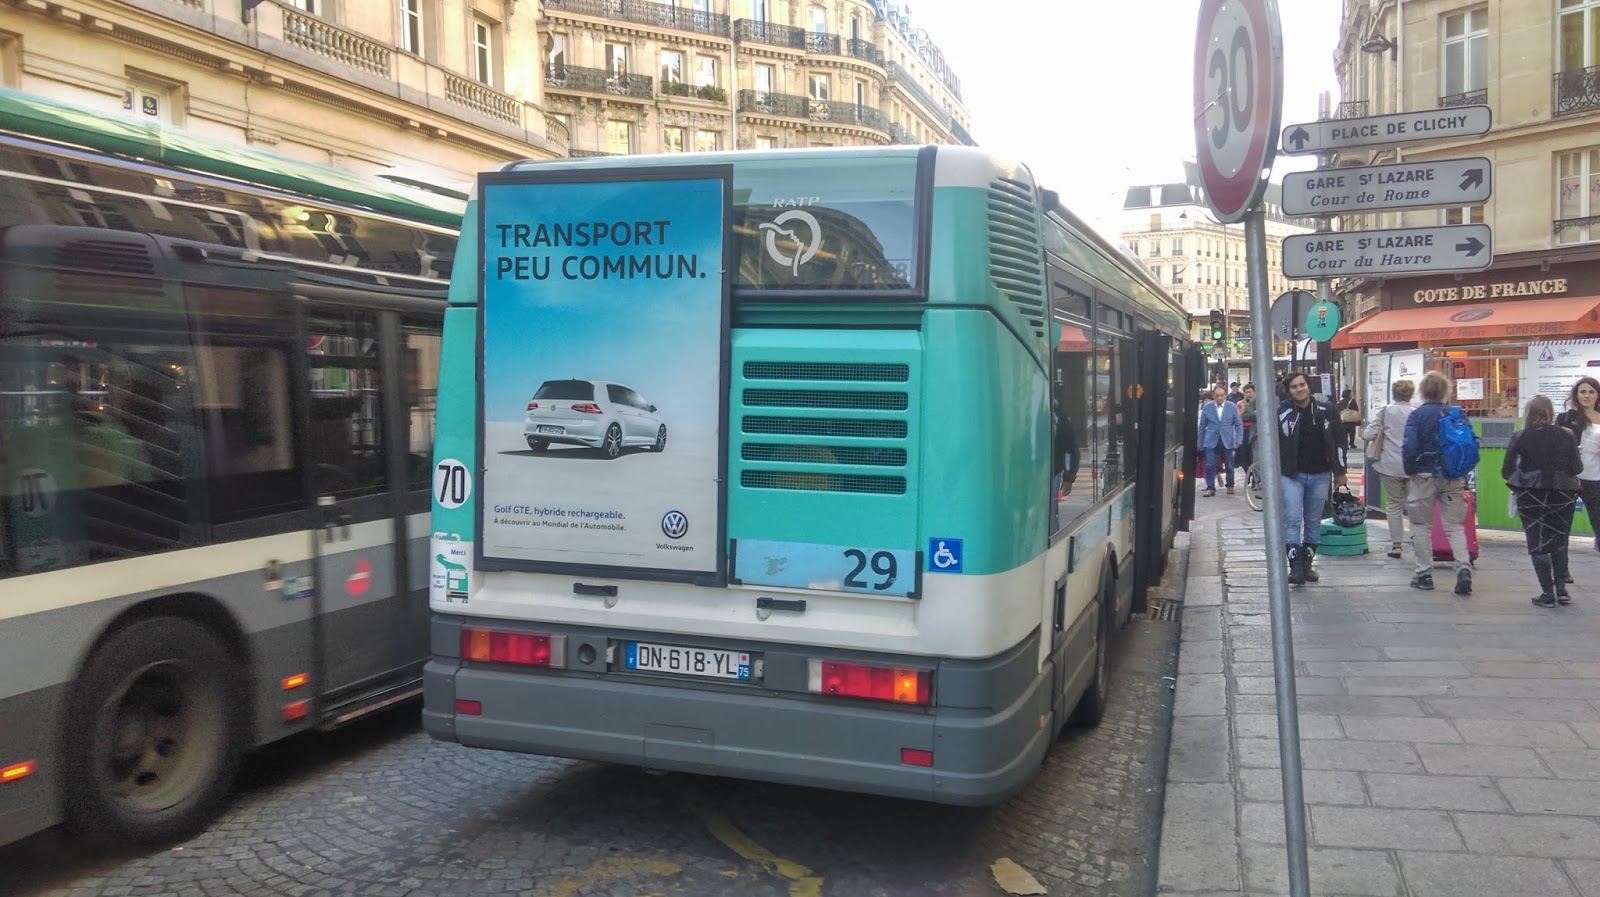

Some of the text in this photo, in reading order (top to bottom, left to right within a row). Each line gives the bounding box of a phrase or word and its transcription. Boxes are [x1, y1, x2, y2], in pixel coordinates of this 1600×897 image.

[1208, 25, 1254, 149] 30
[1332, 116, 1467, 140] PLACE DE CLICHY
[1306, 176, 1345, 190] GARE
[1378, 169, 1434, 184] LAZARE
[773, 196, 820, 208] RATP
[1310, 189, 1430, 207] Cour de Rome
[496, 221, 671, 248] TRANSPORT
[1305, 240, 1344, 253] GARE
[1377, 235, 1433, 249] LAZARE
[497, 254, 706, 280] PEU COMMUN.
[1307, 254, 1432, 270] Cour du Havre
[1414, 278, 1567, 304] COTE DE FRANCE
[1356, 332, 1401, 342] CHOCOLATS
[1505, 323, 1566, 334] CONFISERIES
[438, 465, 466, 504] 70
[494, 505, 626, 520] Golf GTE, hybride rechargeable.
[500, 518, 531, 526] découvrir
[655, 543, 694, 552] Volkswagen
[843, 549, 898, 590] 29
[639, 646, 737, 675] DN-618-YL
[739, 667, 749, 677] 75
